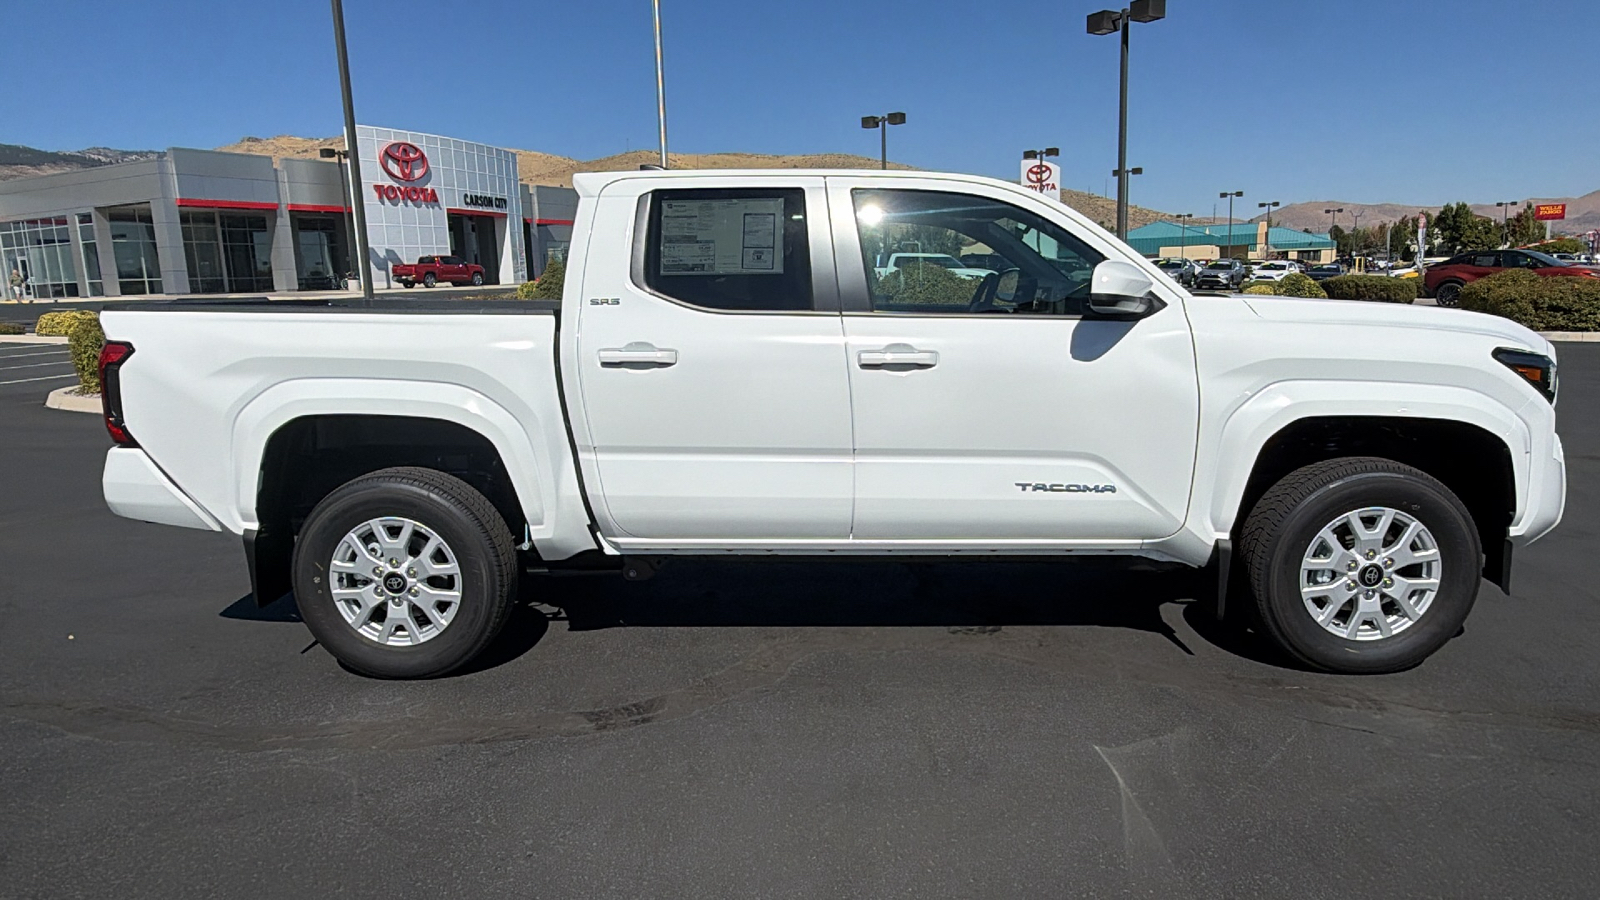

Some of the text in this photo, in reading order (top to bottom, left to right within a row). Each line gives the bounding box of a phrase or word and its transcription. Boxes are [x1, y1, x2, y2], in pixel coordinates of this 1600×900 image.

[373, 184, 439, 203] TOYOTA
[464, 193, 507, 208] CARSON CITY
[1015, 482, 1117, 493] TACOMA
